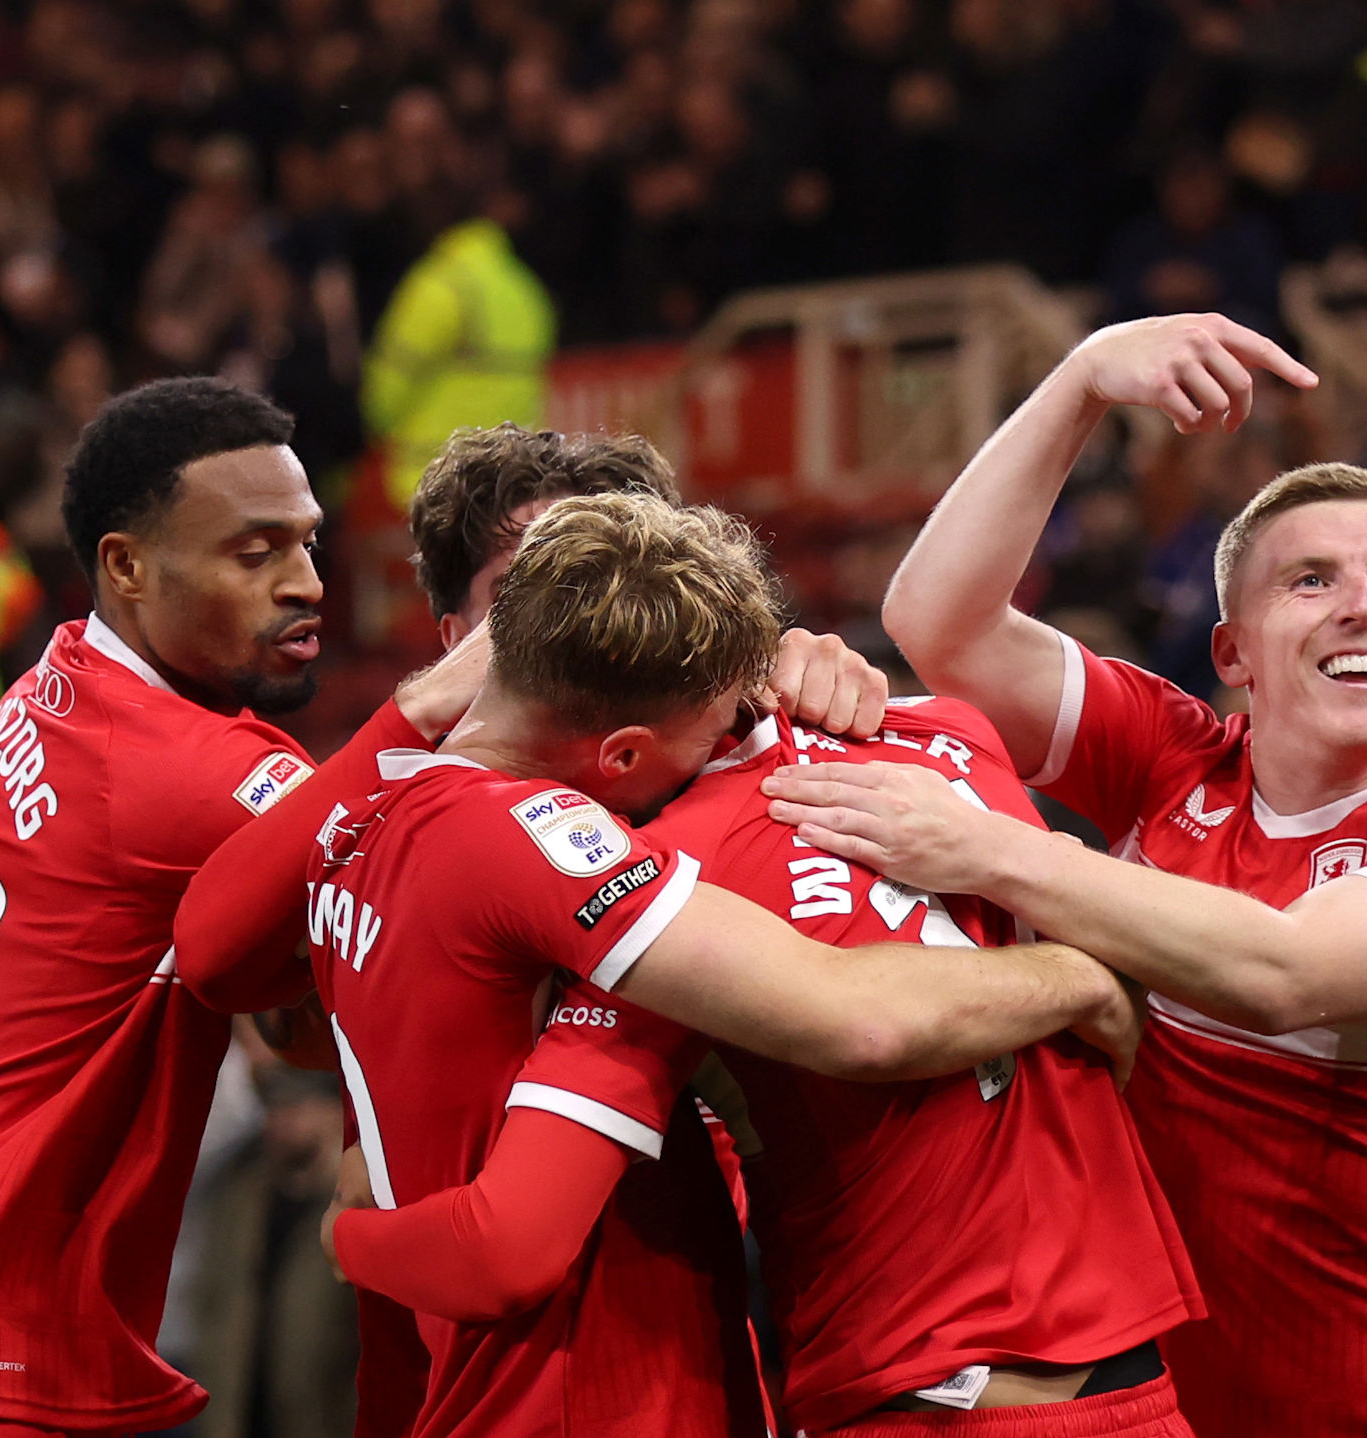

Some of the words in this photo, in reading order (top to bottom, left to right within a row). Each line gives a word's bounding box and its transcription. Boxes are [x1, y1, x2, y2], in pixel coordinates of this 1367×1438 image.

[250, 777, 275, 806] sky
[269, 759, 296, 781] bet
[525, 801, 554, 823] sky
[555, 793, 588, 808] bet
[1168, 810, 1208, 842] ASTOR
[585, 844, 614, 865] EFL
[307, 881, 383, 973] WAY
[545, 999, 618, 1029] lcoss
